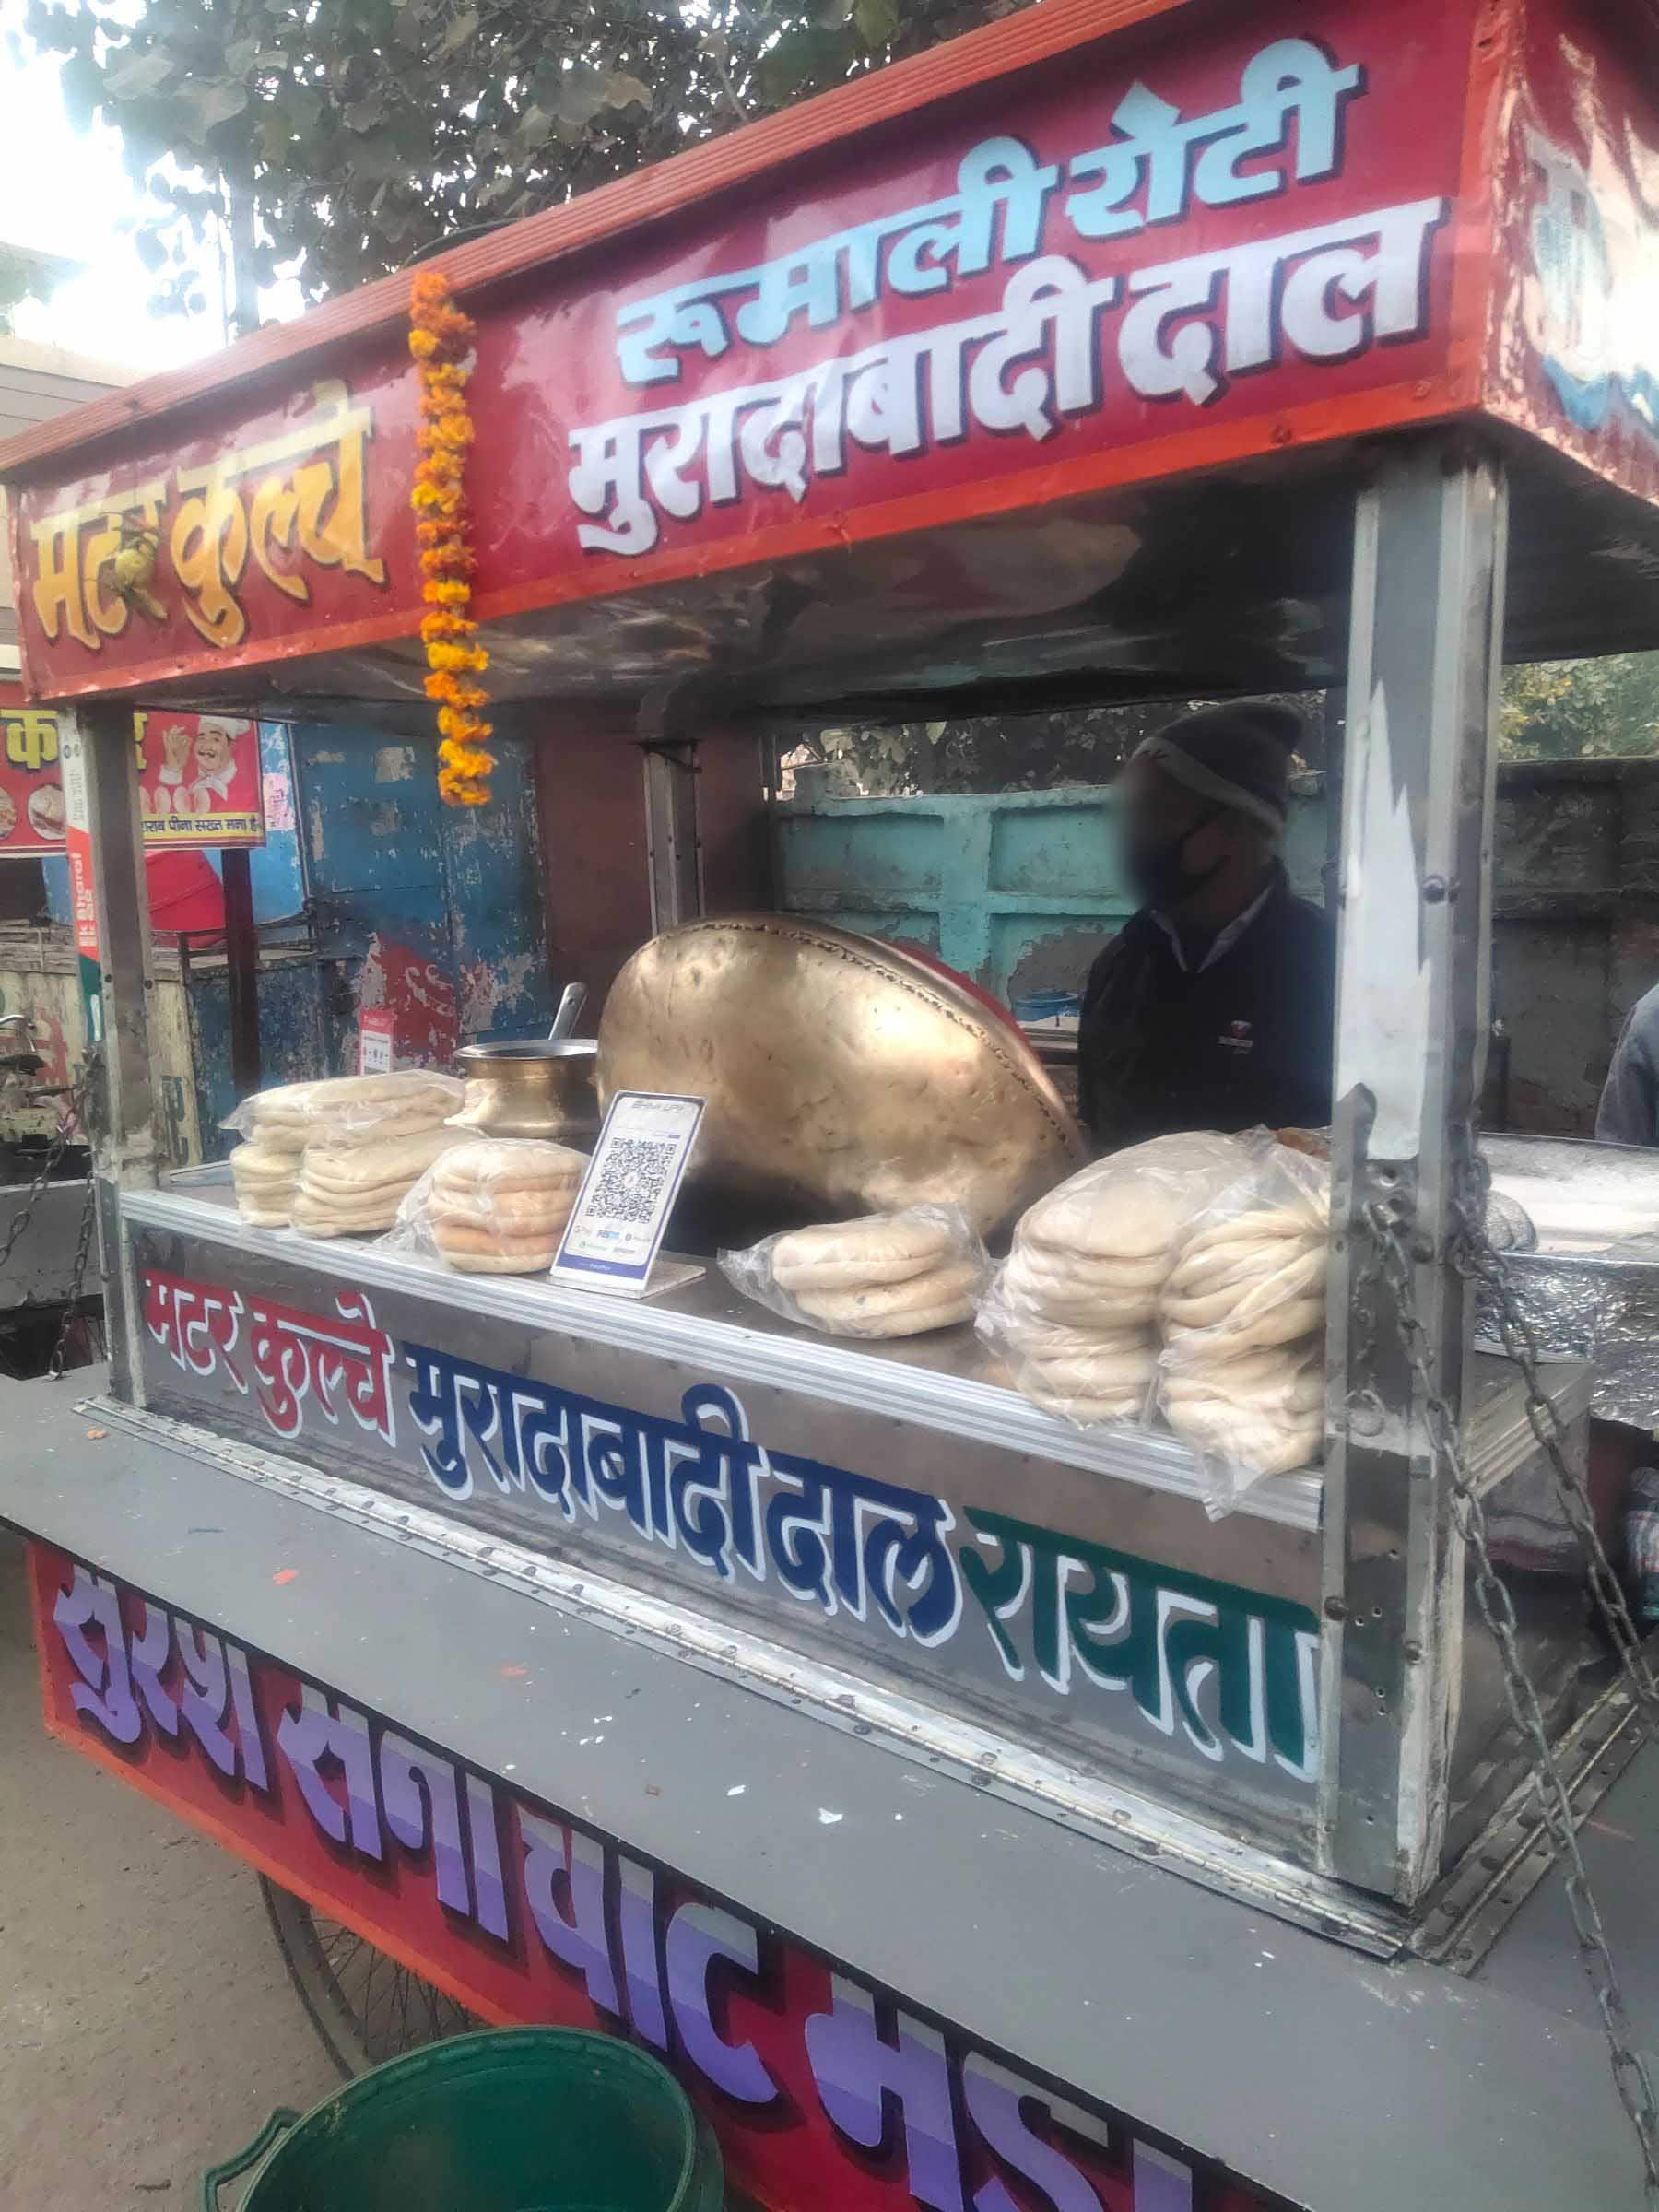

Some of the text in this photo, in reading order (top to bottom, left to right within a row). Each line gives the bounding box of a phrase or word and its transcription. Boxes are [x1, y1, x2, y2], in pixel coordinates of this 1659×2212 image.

[1064, 37, 1360, 238] रोटी
[566, 195, 1449, 557] मुरादाबादी दाल
[141, 1271, 248, 1393] मटर
[398, 1338, 771, 1583] मुरादाबादी
[771, 1445, 963, 1647] दाल
[959, 1506, 1322, 1783] रायता
